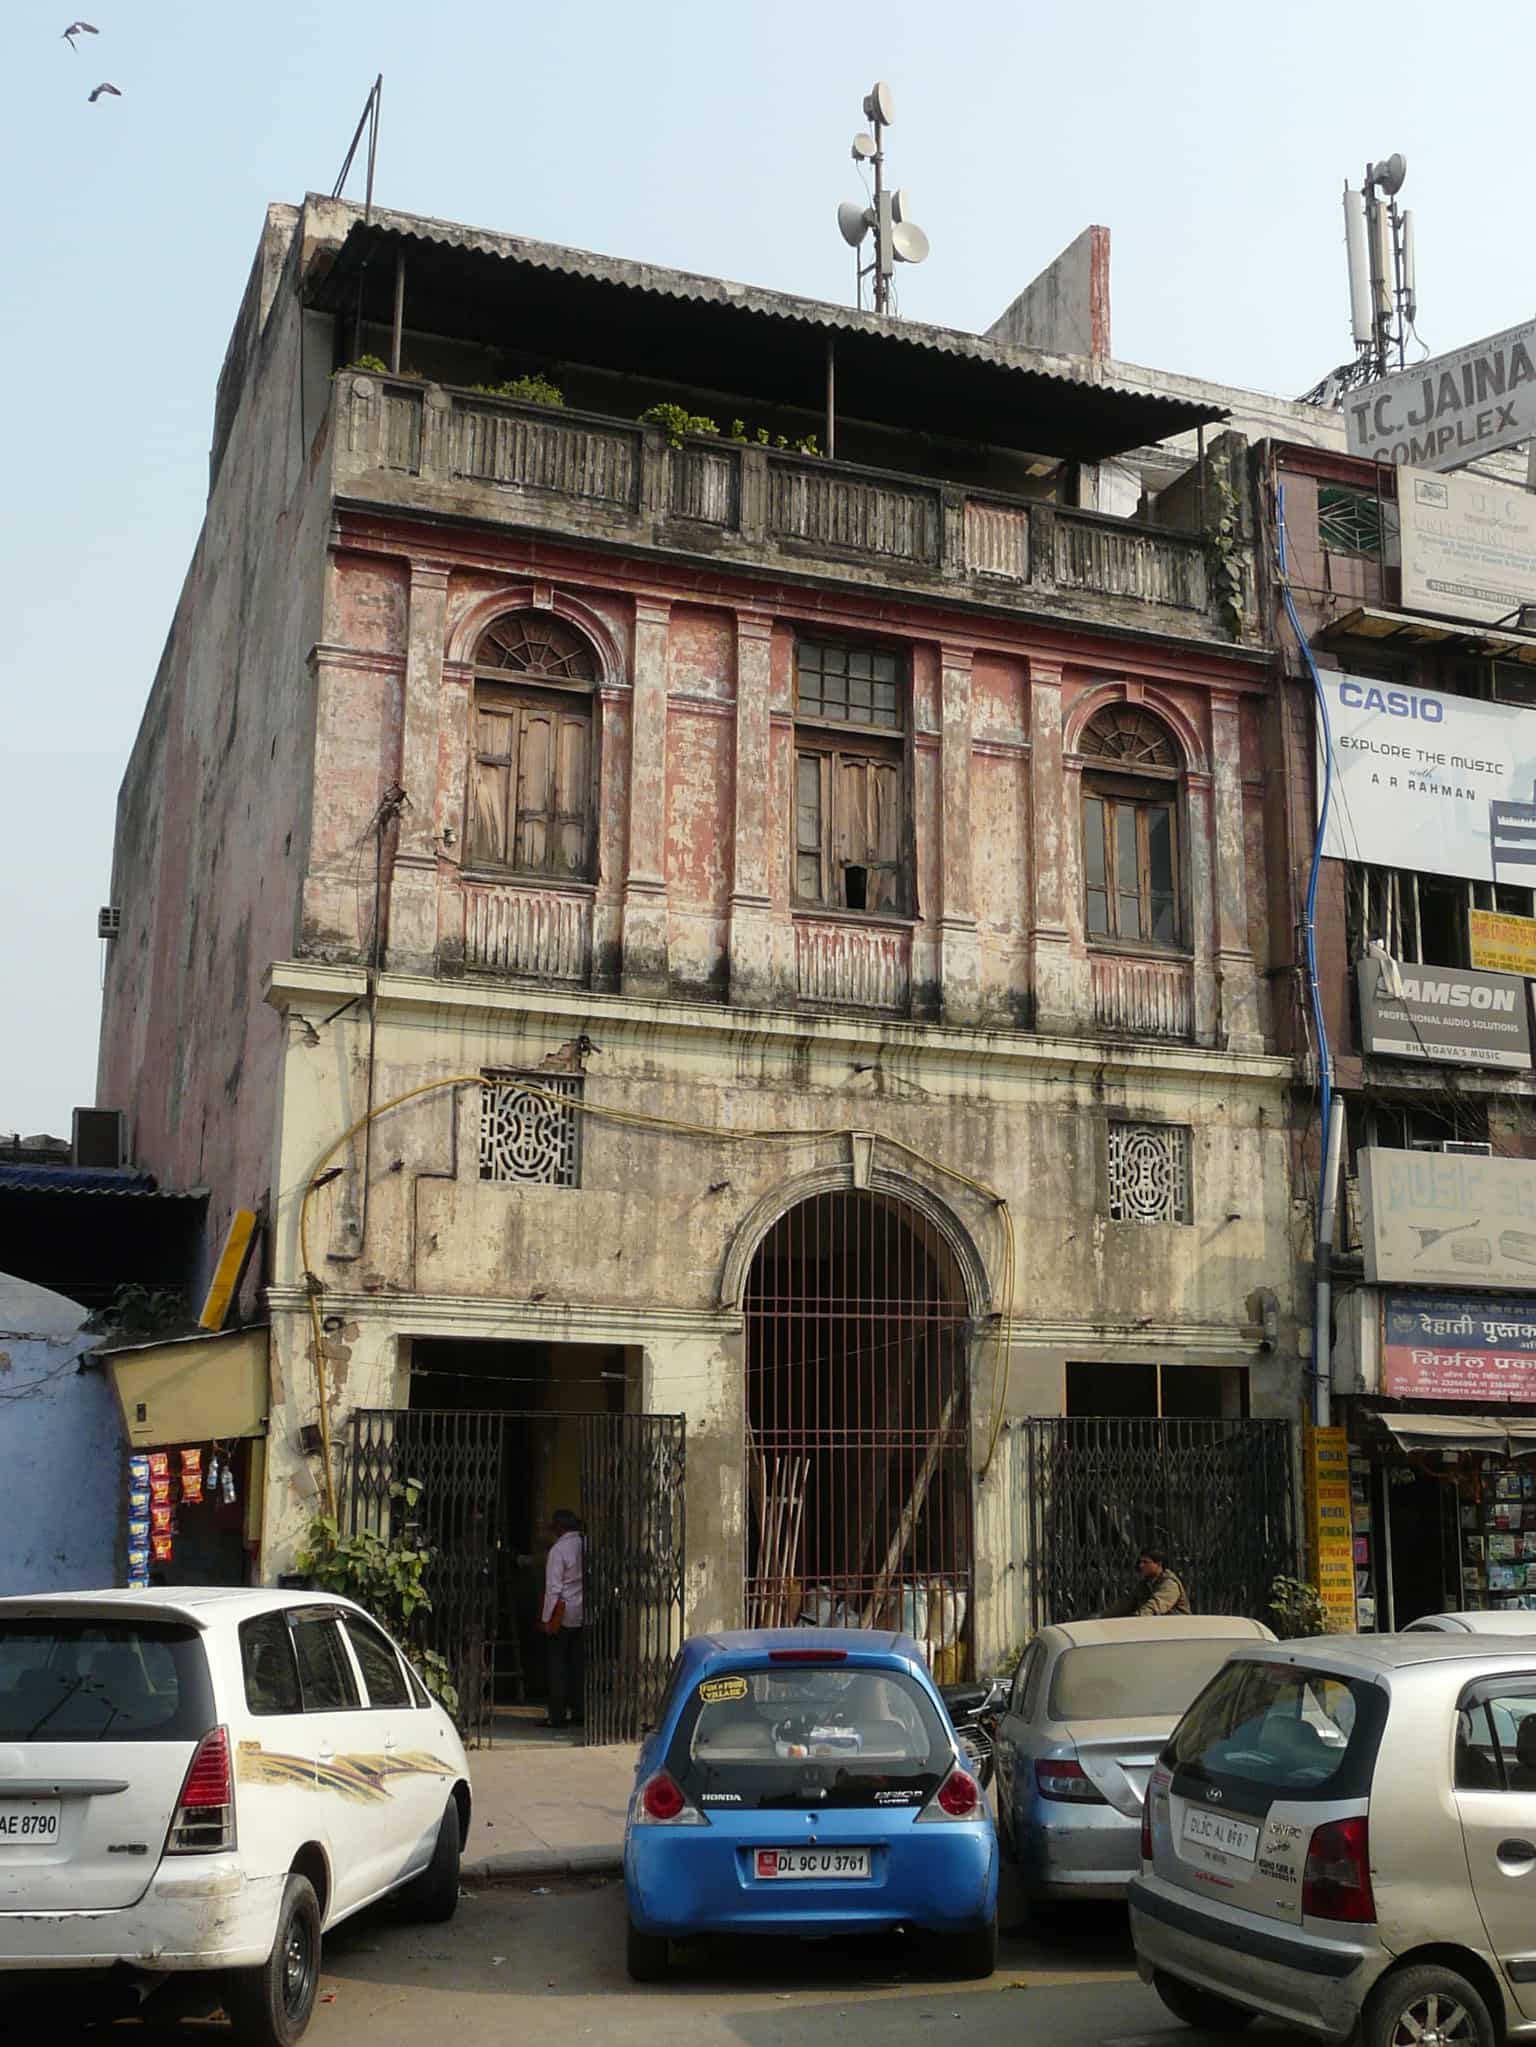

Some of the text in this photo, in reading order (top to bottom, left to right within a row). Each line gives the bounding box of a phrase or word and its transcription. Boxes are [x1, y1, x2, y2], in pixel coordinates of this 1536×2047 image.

[1373, 399, 1519, 465] COMPLEX
[1339, 682, 1443, 723] CASIO
[1340, 736, 1504, 775] EXPLORE THE MUSIC
[1371, 773, 1476, 800] A R RAHMAN
[1442, 1017, 1470, 1028] AUDIO
[1472, 1020, 1519, 1033] SOLUTIONS
[1470, 1048, 1500, 1061] MUSIC
[1419, 1312, 1477, 1335] देहाती
[1411, 1350, 1487, 1368] निर्मल
[702, 1793, 741, 1801] HONDA
[22, 1816, 56, 1834] 8790
[778, 1855, 864, 1871] DL 9C U 3761
